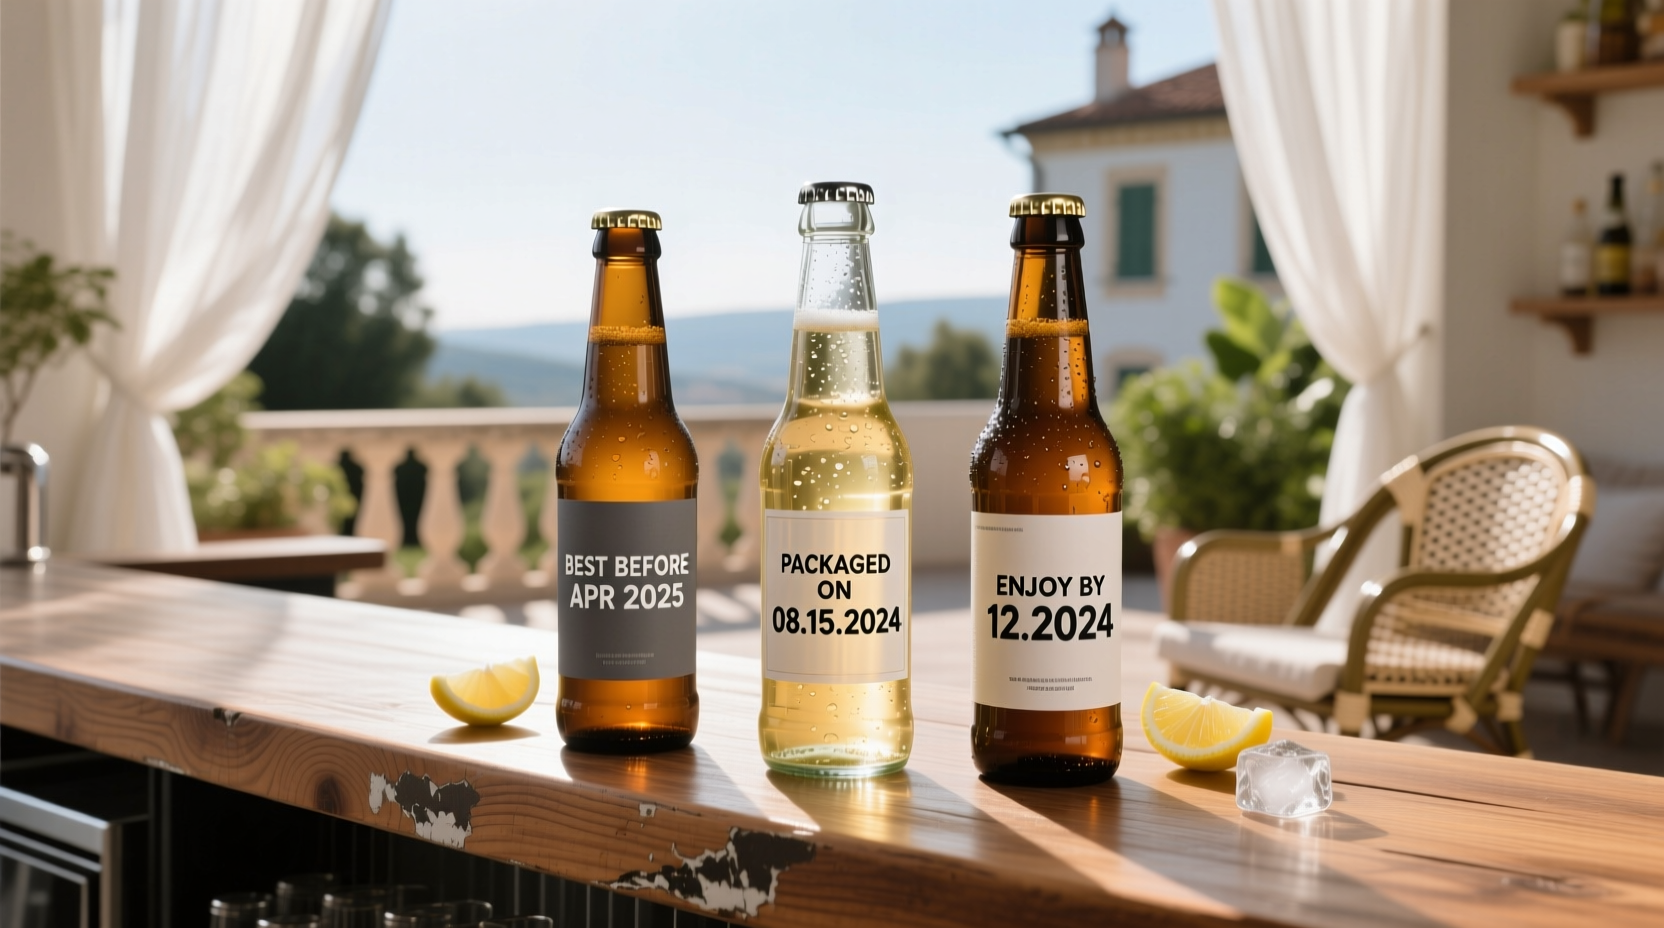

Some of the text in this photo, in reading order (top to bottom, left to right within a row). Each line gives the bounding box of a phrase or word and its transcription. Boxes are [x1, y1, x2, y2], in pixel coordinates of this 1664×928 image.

[565, 552, 689, 577] BEST BEFORE
[781, 553, 891, 575] PACKAGED
[570, 582, 684, 610] APR 2025
[817, 580, 851, 600] ON
[996, 574, 1106, 597] ENJOY BY
[772, 606, 902, 635] 08.15.2024
[987, 602, 1114, 642] 12.2024
